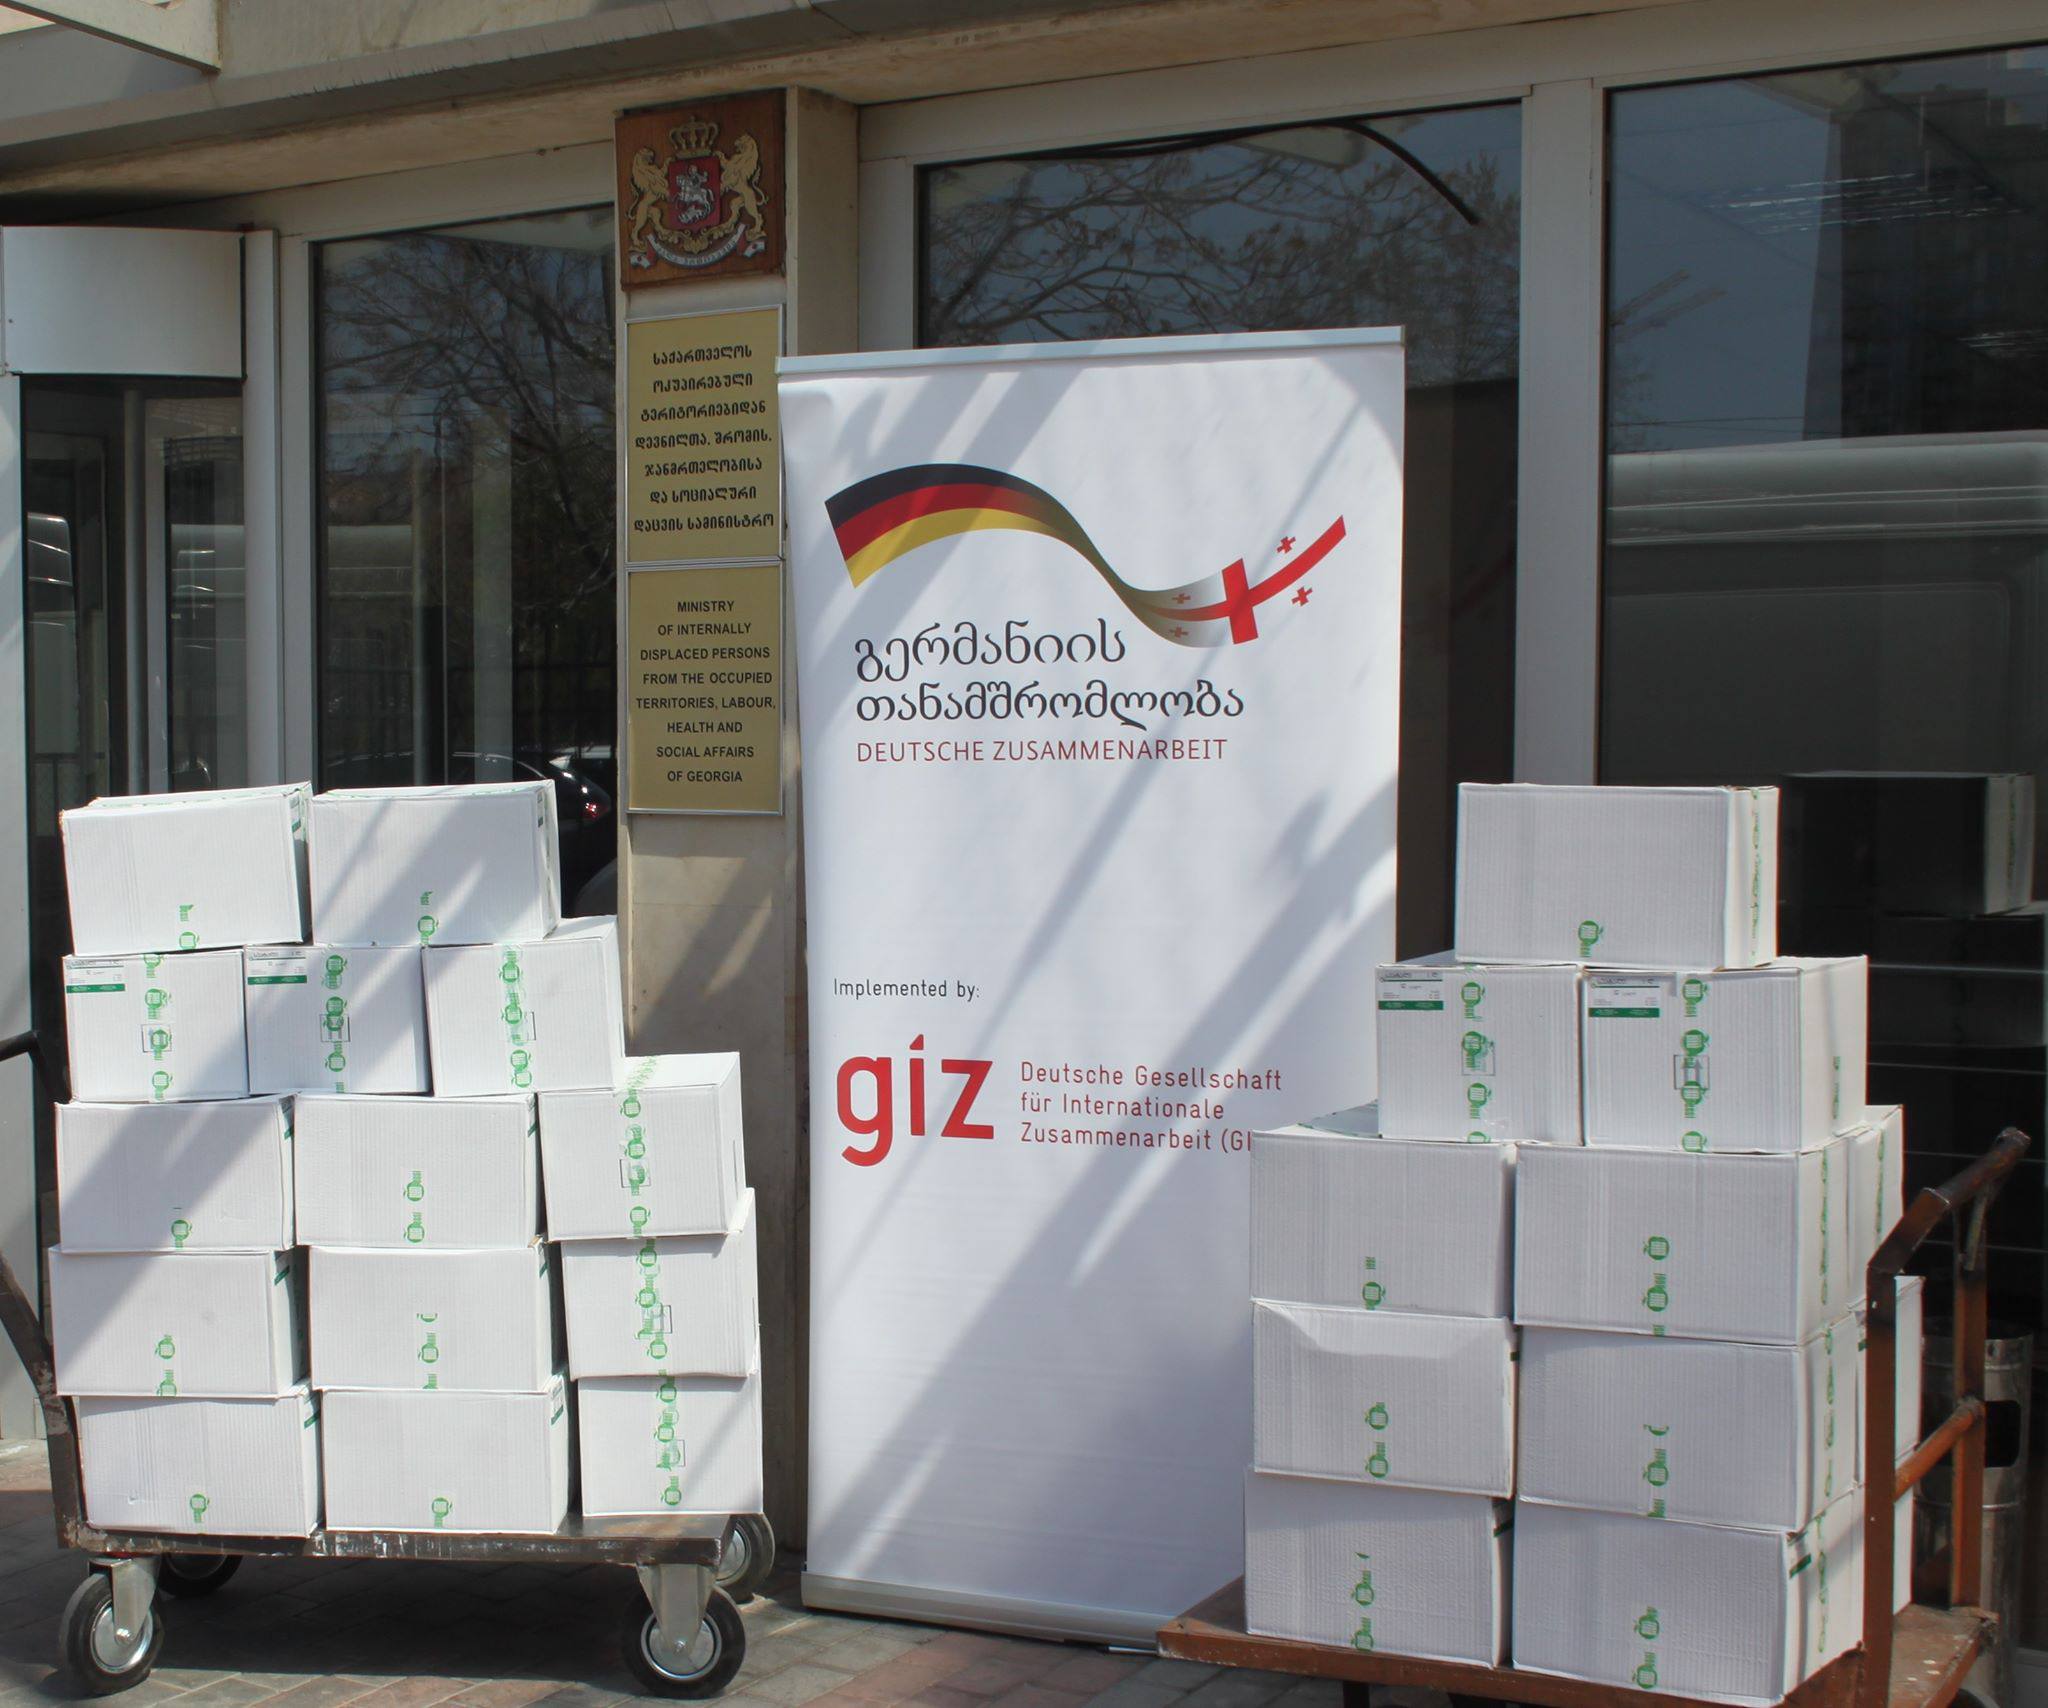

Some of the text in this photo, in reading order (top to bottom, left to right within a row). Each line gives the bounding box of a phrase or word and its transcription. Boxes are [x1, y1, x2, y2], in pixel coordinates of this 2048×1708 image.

[650, 491, 667, 503] და
[634, 518, 683, 532] დაცვის
[678, 601, 734, 612] MINISTRY
[658, 623, 751, 635] OF INTERNALLY
[641, 647, 770, 660] DISPLACED PERSONS
[854, 617, 1126, 683] გერმანიის
[643, 672, 772, 684] FROM THE OCCUPIED
[636, 697, 775, 709] TERRITORIES, LABOUR,
[856, 679, 1245, 732] თანამშრომლობა
[668, 722, 742, 733] HEALTH AND
[657, 746, 754, 757] SOCIAL AFFAIRS
[857, 738, 1228, 762] DEUTSCHE ZUSAMMENARBEIT
[668, 771, 742, 782] OF GEORGIA
[833, 977, 980, 1002] Implemented by:
[1022, 1062, 1282, 1091] Deutsche Gesellschaft
[836, 1034, 994, 1167] giz
[1021, 1092, 1225, 1120] für Internationale
[1020, 1122, 1251, 1153] Zusammenarbeit (GI
